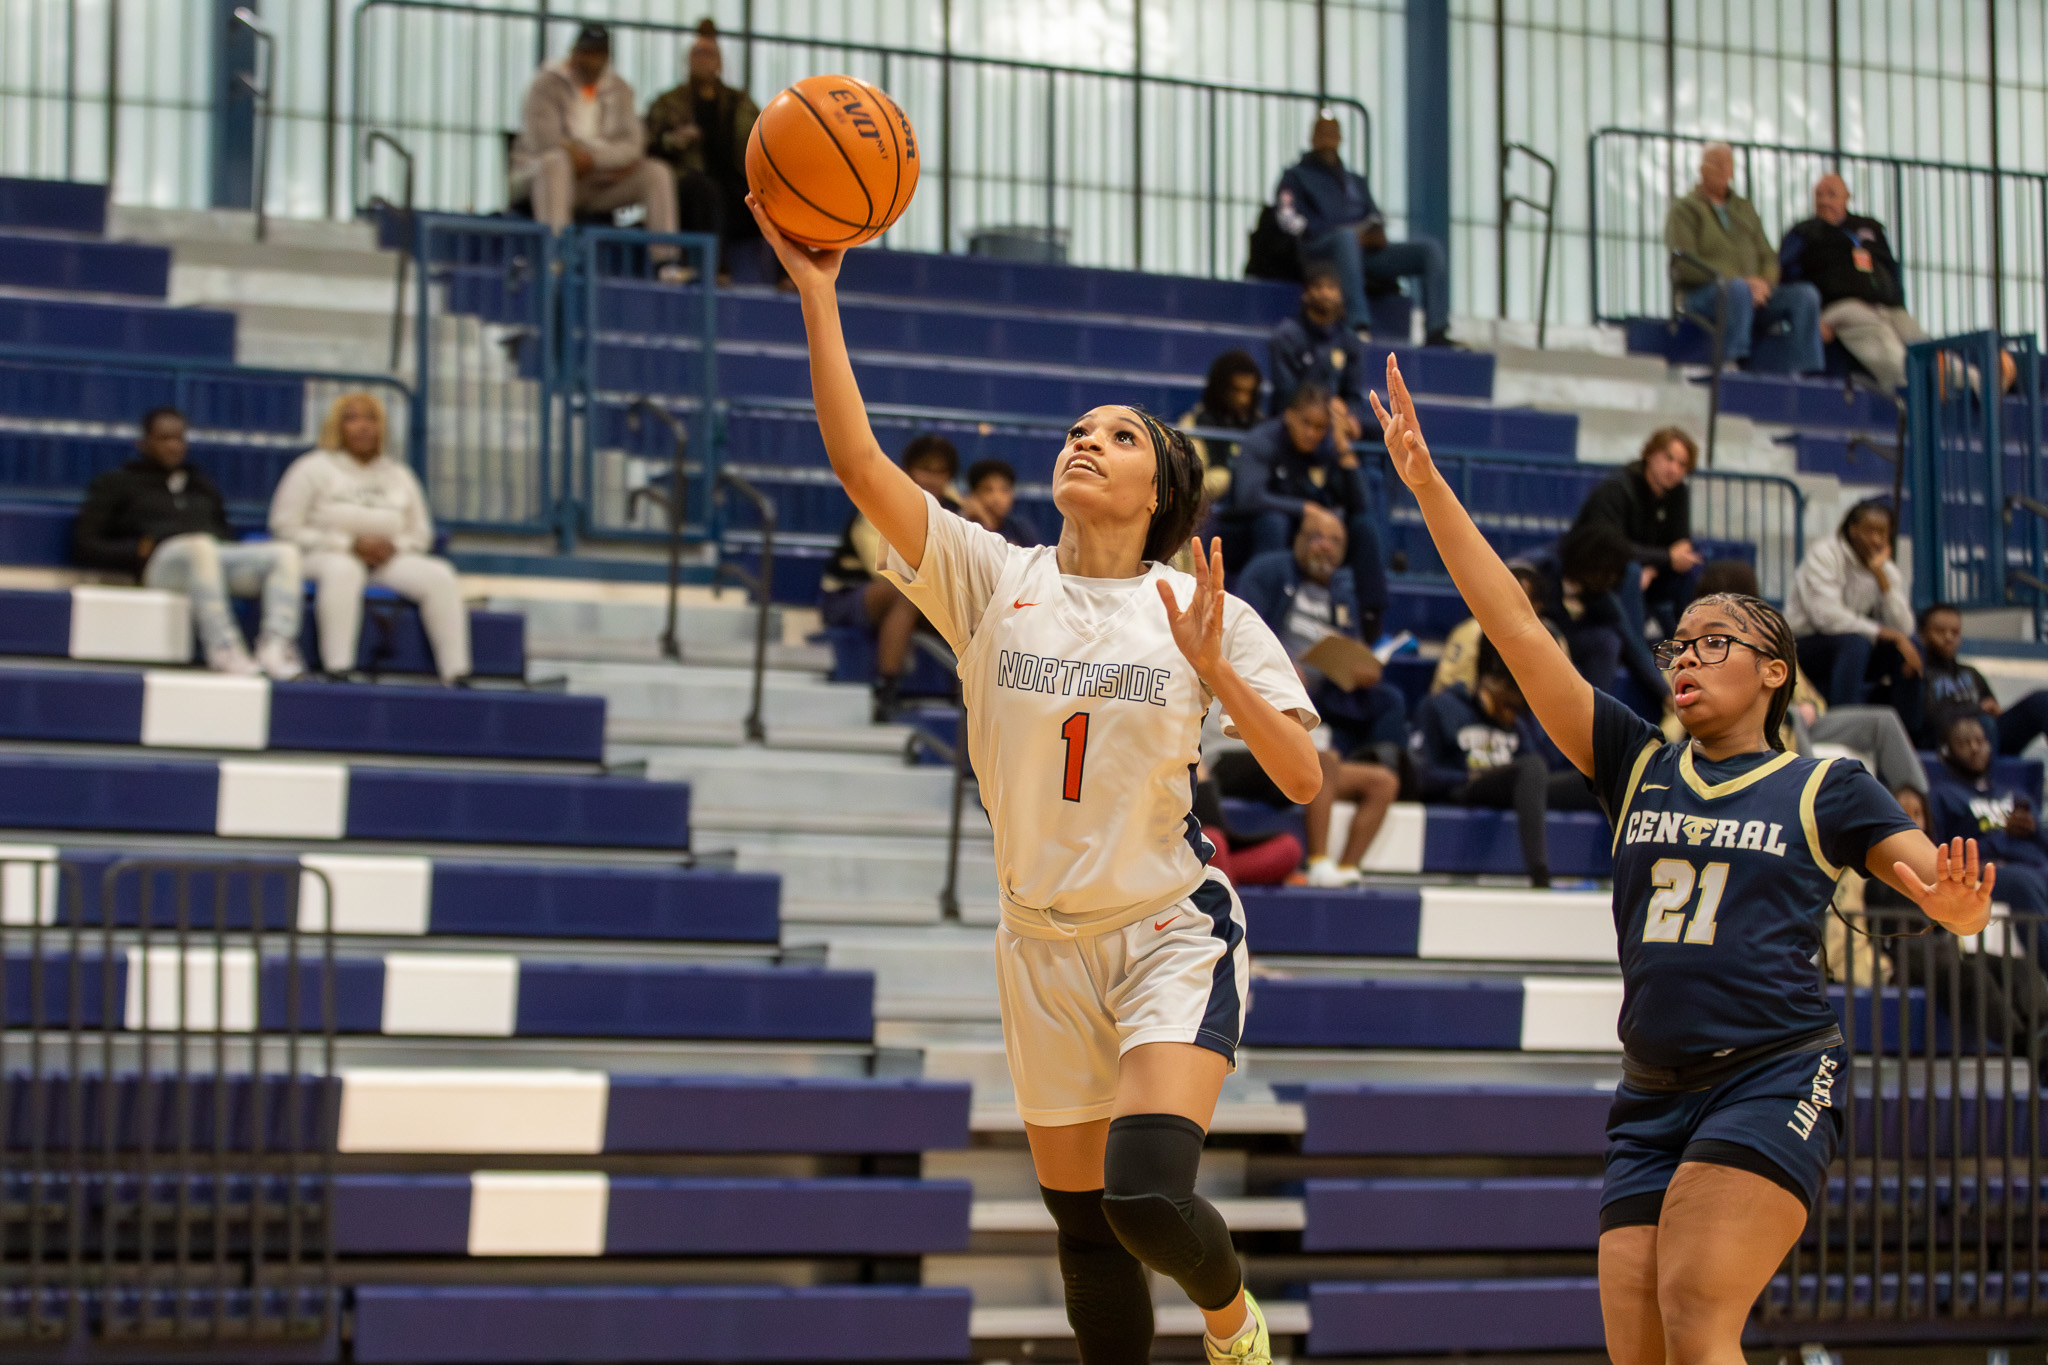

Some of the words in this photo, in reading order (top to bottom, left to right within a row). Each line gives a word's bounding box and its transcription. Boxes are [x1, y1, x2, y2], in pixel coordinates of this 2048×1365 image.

[828, 89, 880, 138] EVO
[998, 649, 1171, 707] NORTHSIDE
[1061, 711, 1090, 803] 1
[1625, 809, 1787, 857] CENTRAL
[1641, 857, 1730, 946] 21
